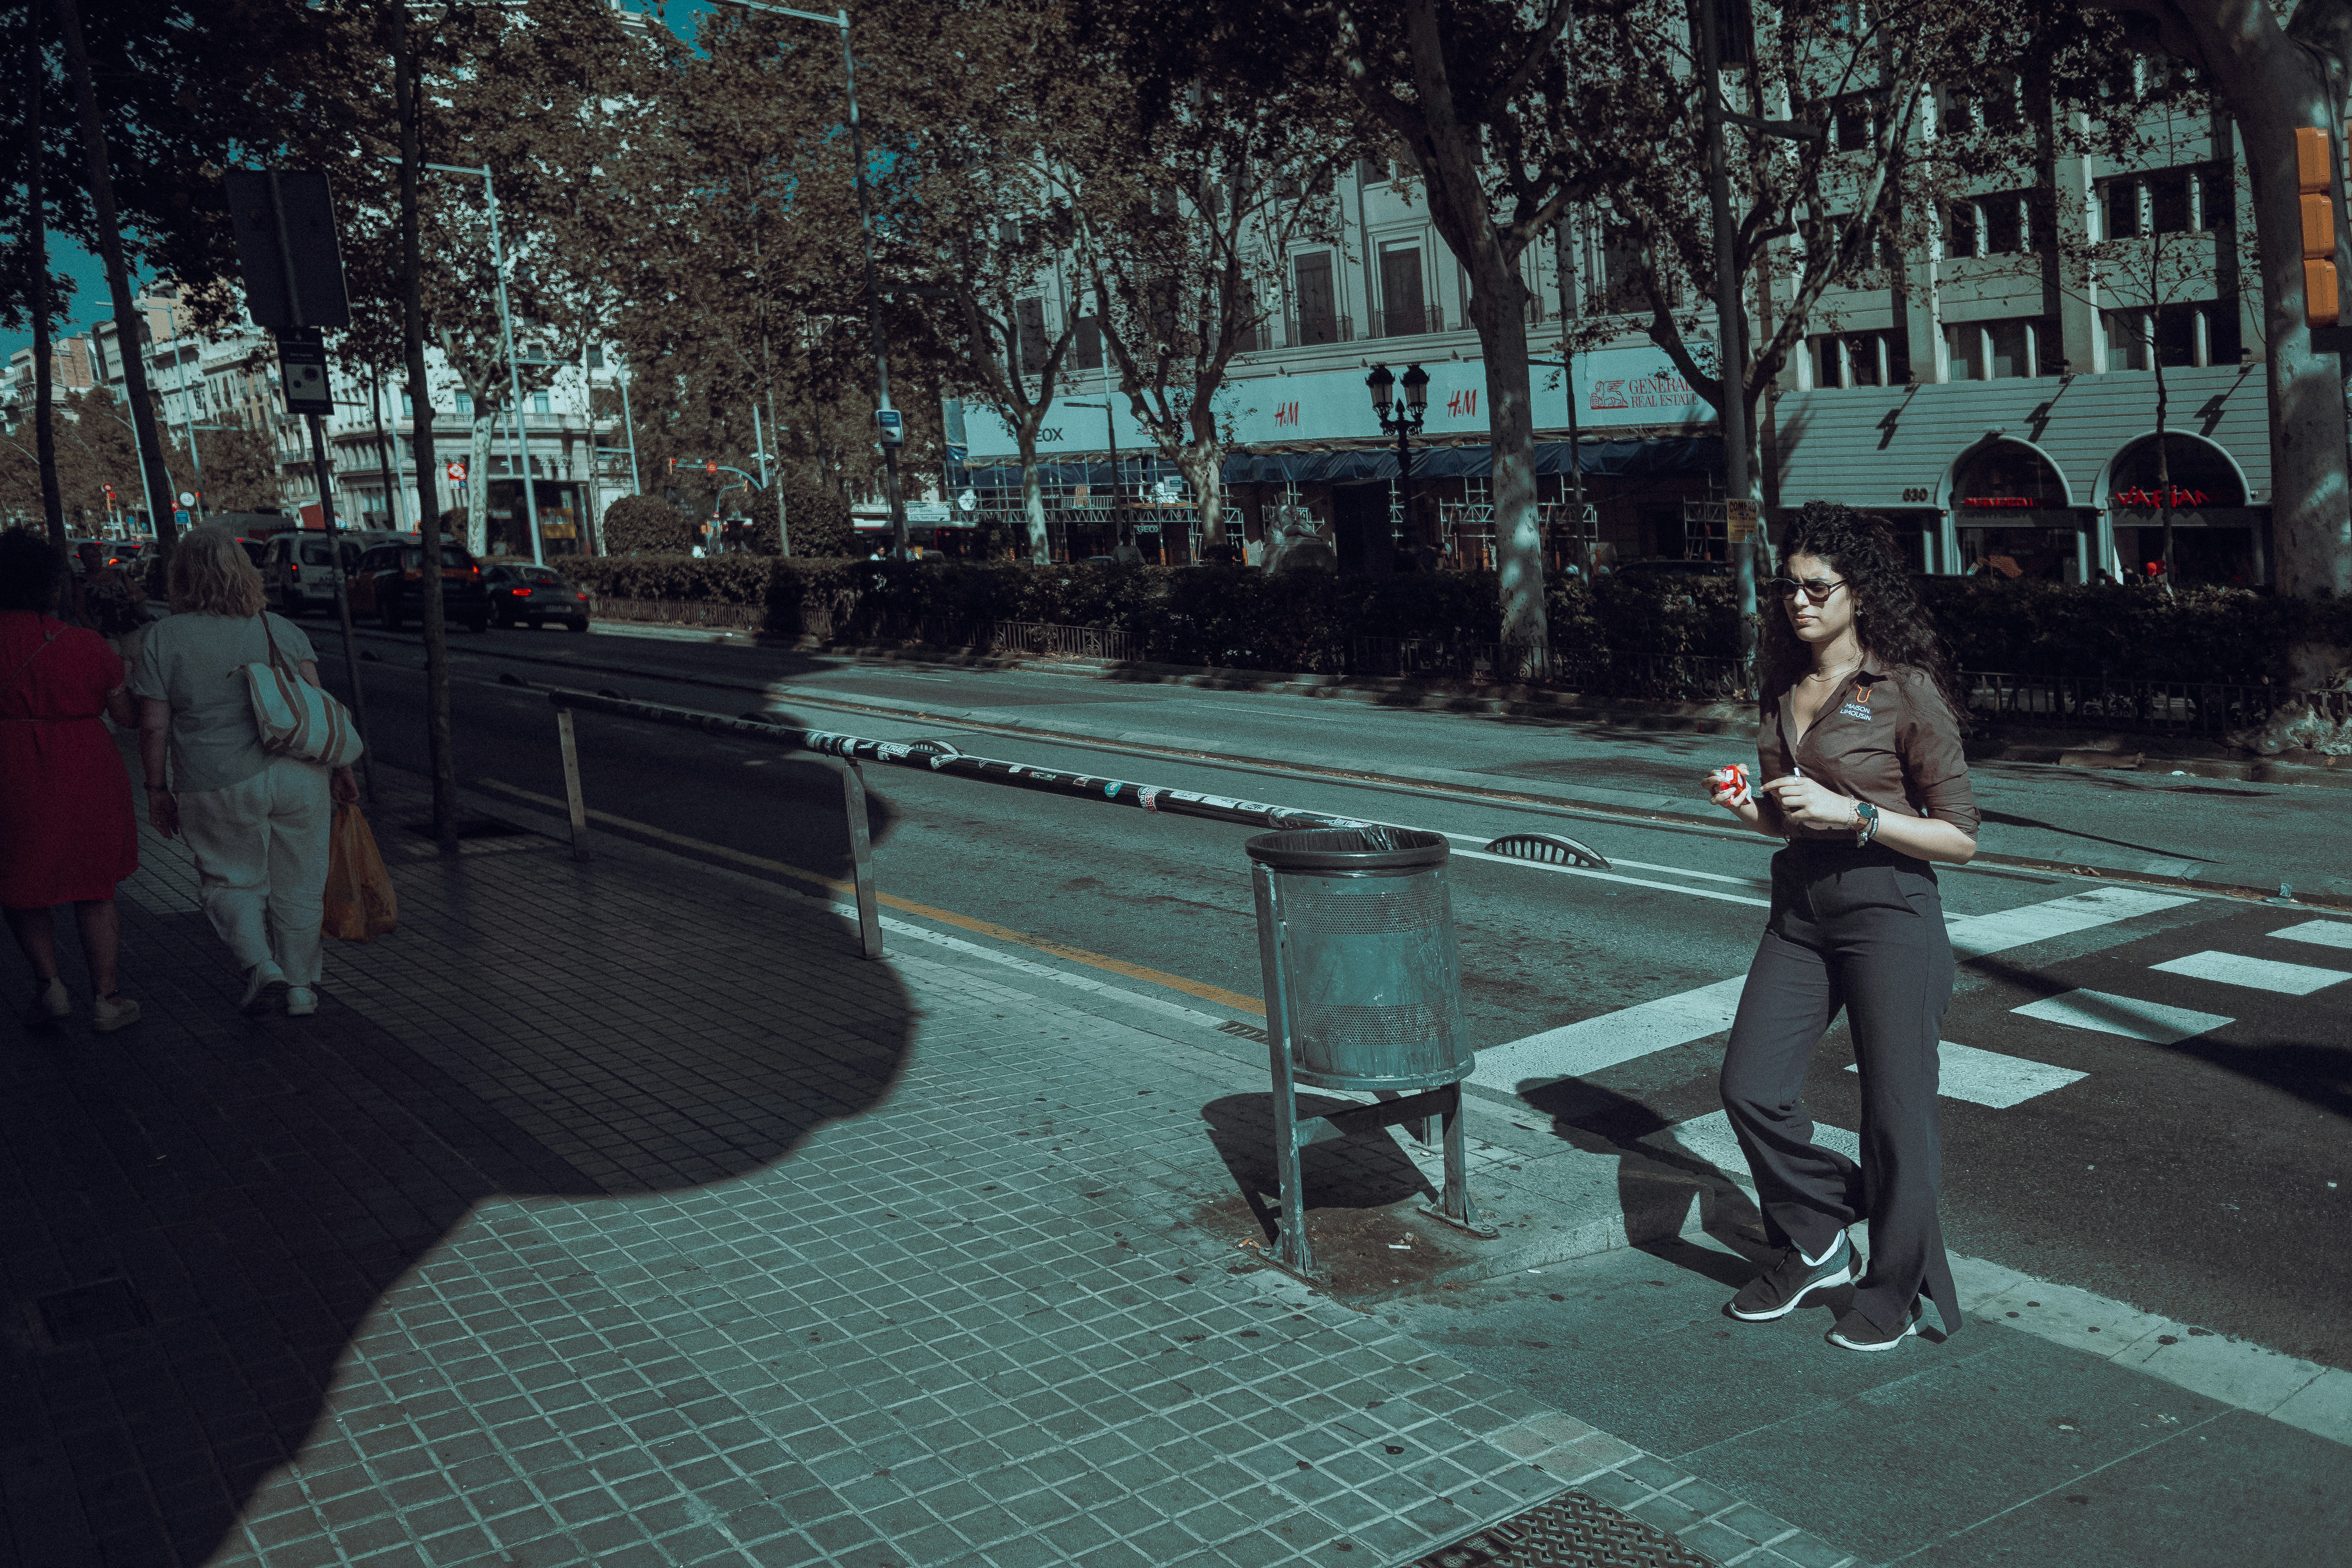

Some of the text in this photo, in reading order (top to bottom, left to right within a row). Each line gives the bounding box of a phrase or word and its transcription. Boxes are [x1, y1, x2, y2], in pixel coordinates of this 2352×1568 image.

[1446, 389, 1477, 418] H&M
[1631, 393, 1699, 408] REAL ESTATE
[1274, 401, 1298, 427] H&M
[1034, 427, 1064, 442] EOX
[1840, 708, 1872, 721] LIMOUSIN
[1844, 703, 1870, 714] MAISON
